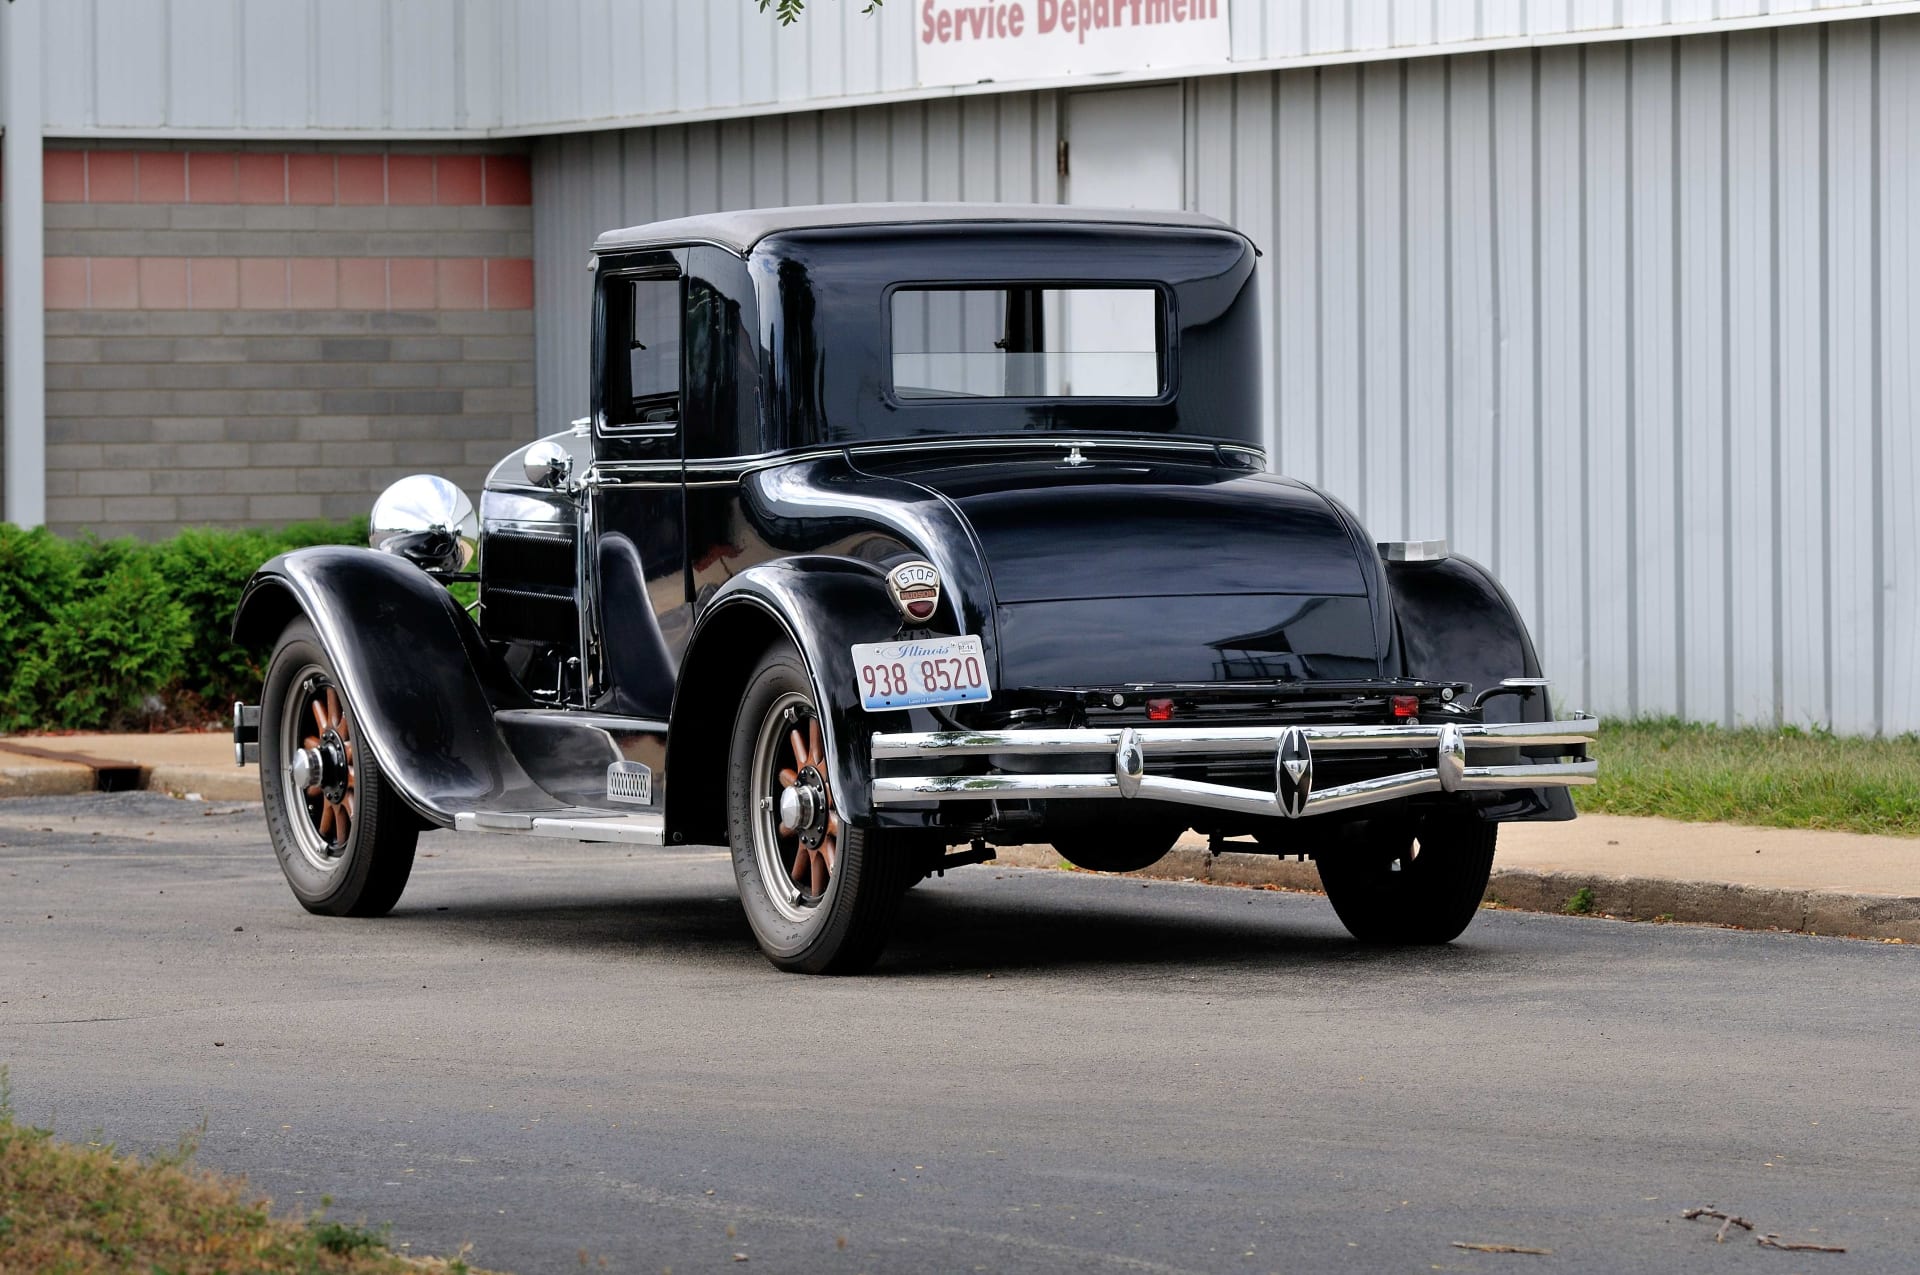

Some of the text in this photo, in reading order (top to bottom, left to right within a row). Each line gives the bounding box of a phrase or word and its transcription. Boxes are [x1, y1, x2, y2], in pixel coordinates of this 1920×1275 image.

[922, 0, 1024, 44] Service
[900, 569, 934, 584] STOP
[901, 589, 935, 600] HUDSON
[896, 644, 950, 658] Illinois
[863, 657, 982, 697] 938 8520
